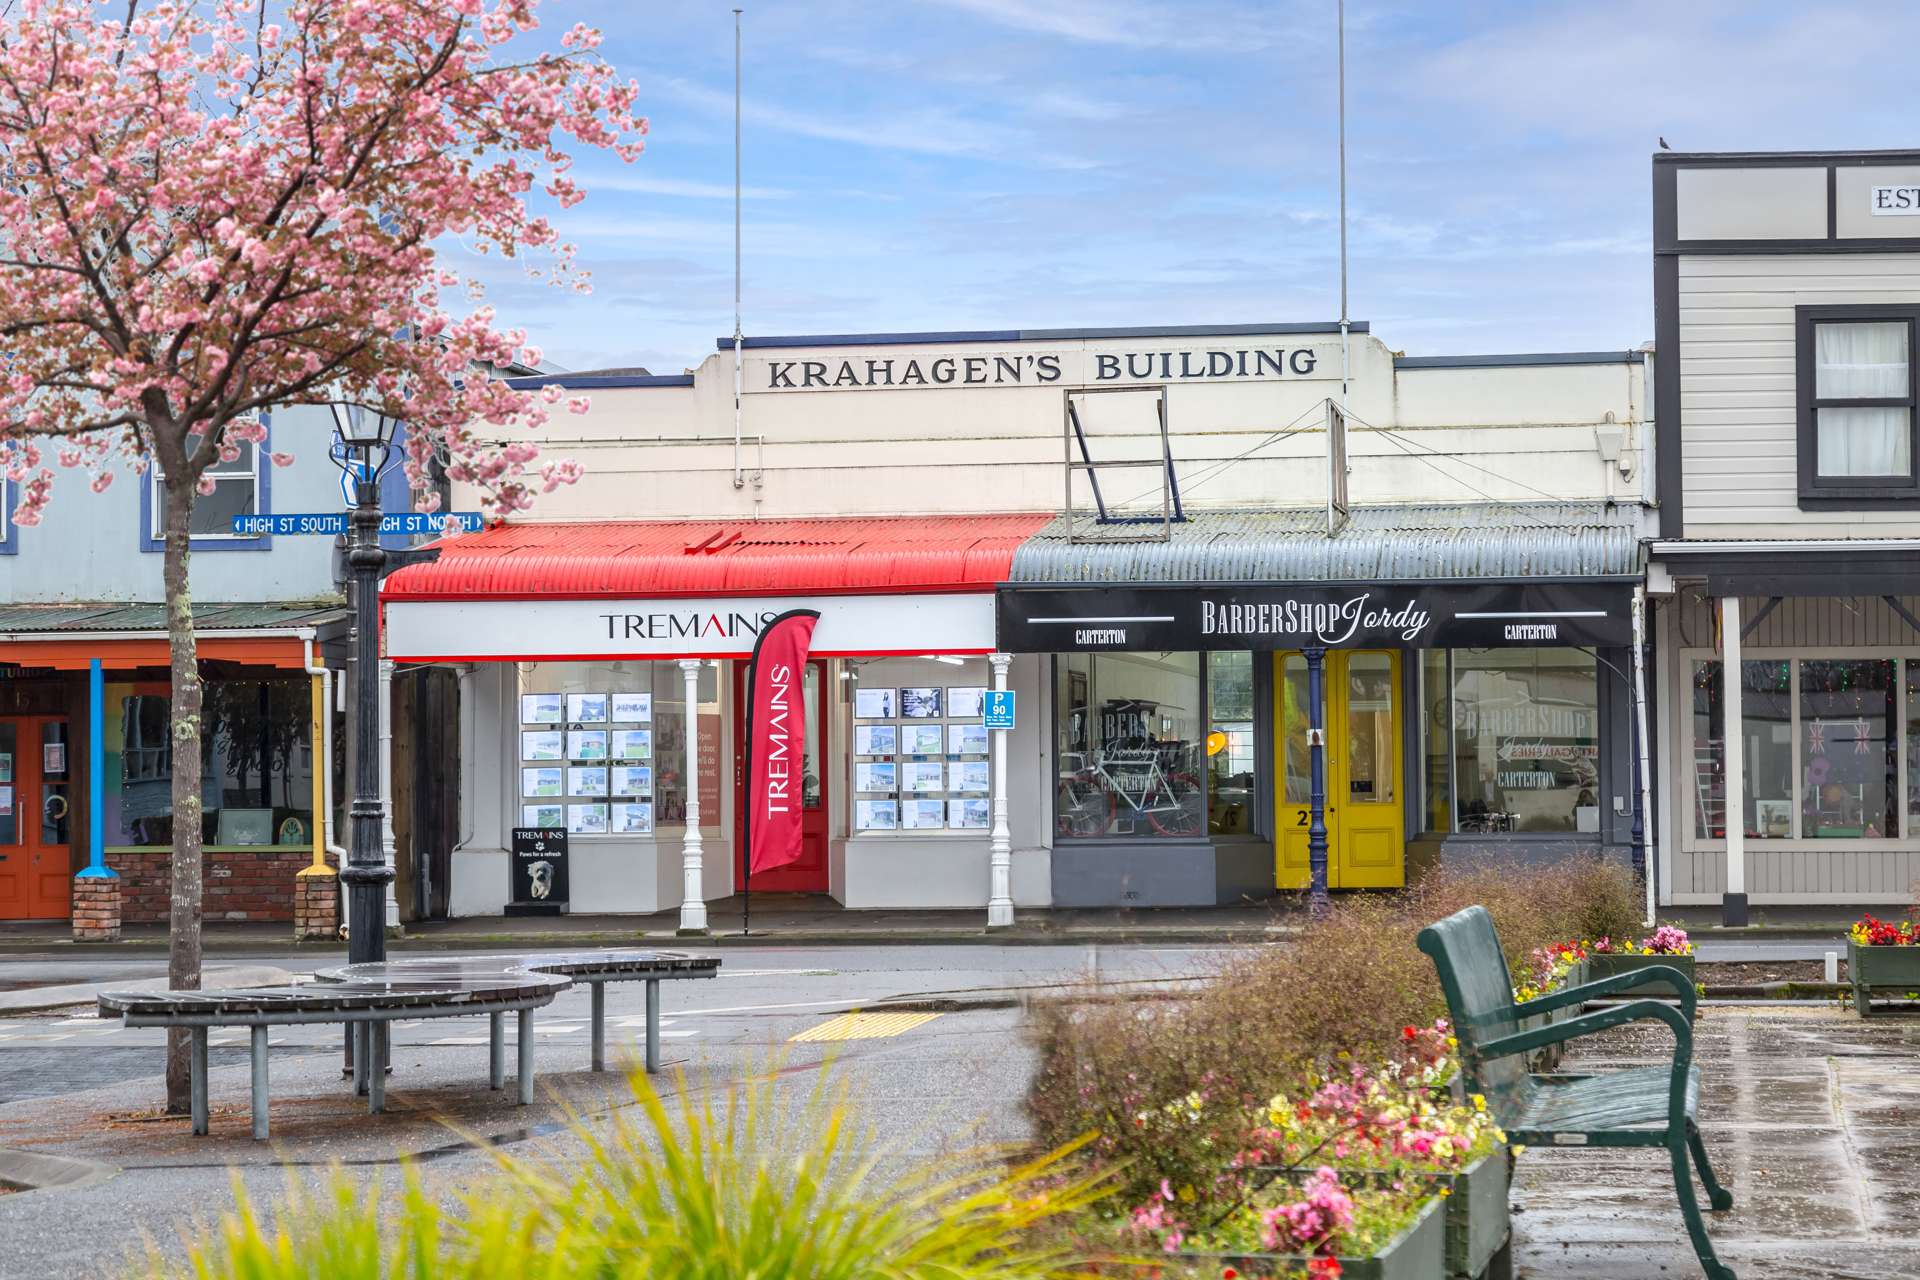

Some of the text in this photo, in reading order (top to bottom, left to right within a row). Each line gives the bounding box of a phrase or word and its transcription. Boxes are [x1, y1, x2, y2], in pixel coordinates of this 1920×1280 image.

[768, 348, 1317, 389] KRAHAGEN'S BUILDING
[244, 516, 342, 532] HIGH ST SOUTH
[406, 516, 422, 531] ST
[1317, 592, 1430, 645] Jordy
[1075, 628, 1126, 645] CARTERTON
[1504, 624, 1557, 640] CARTERTON
[994, 693, 1004, 704] P
[992, 704, 1006, 715] 90
[767, 663, 790, 820] TREMAINS
[1497, 771, 1557, 788] CARTERTON
[1297, 810, 1312, 826] 2
[515, 831, 564, 840] TREMAINS
